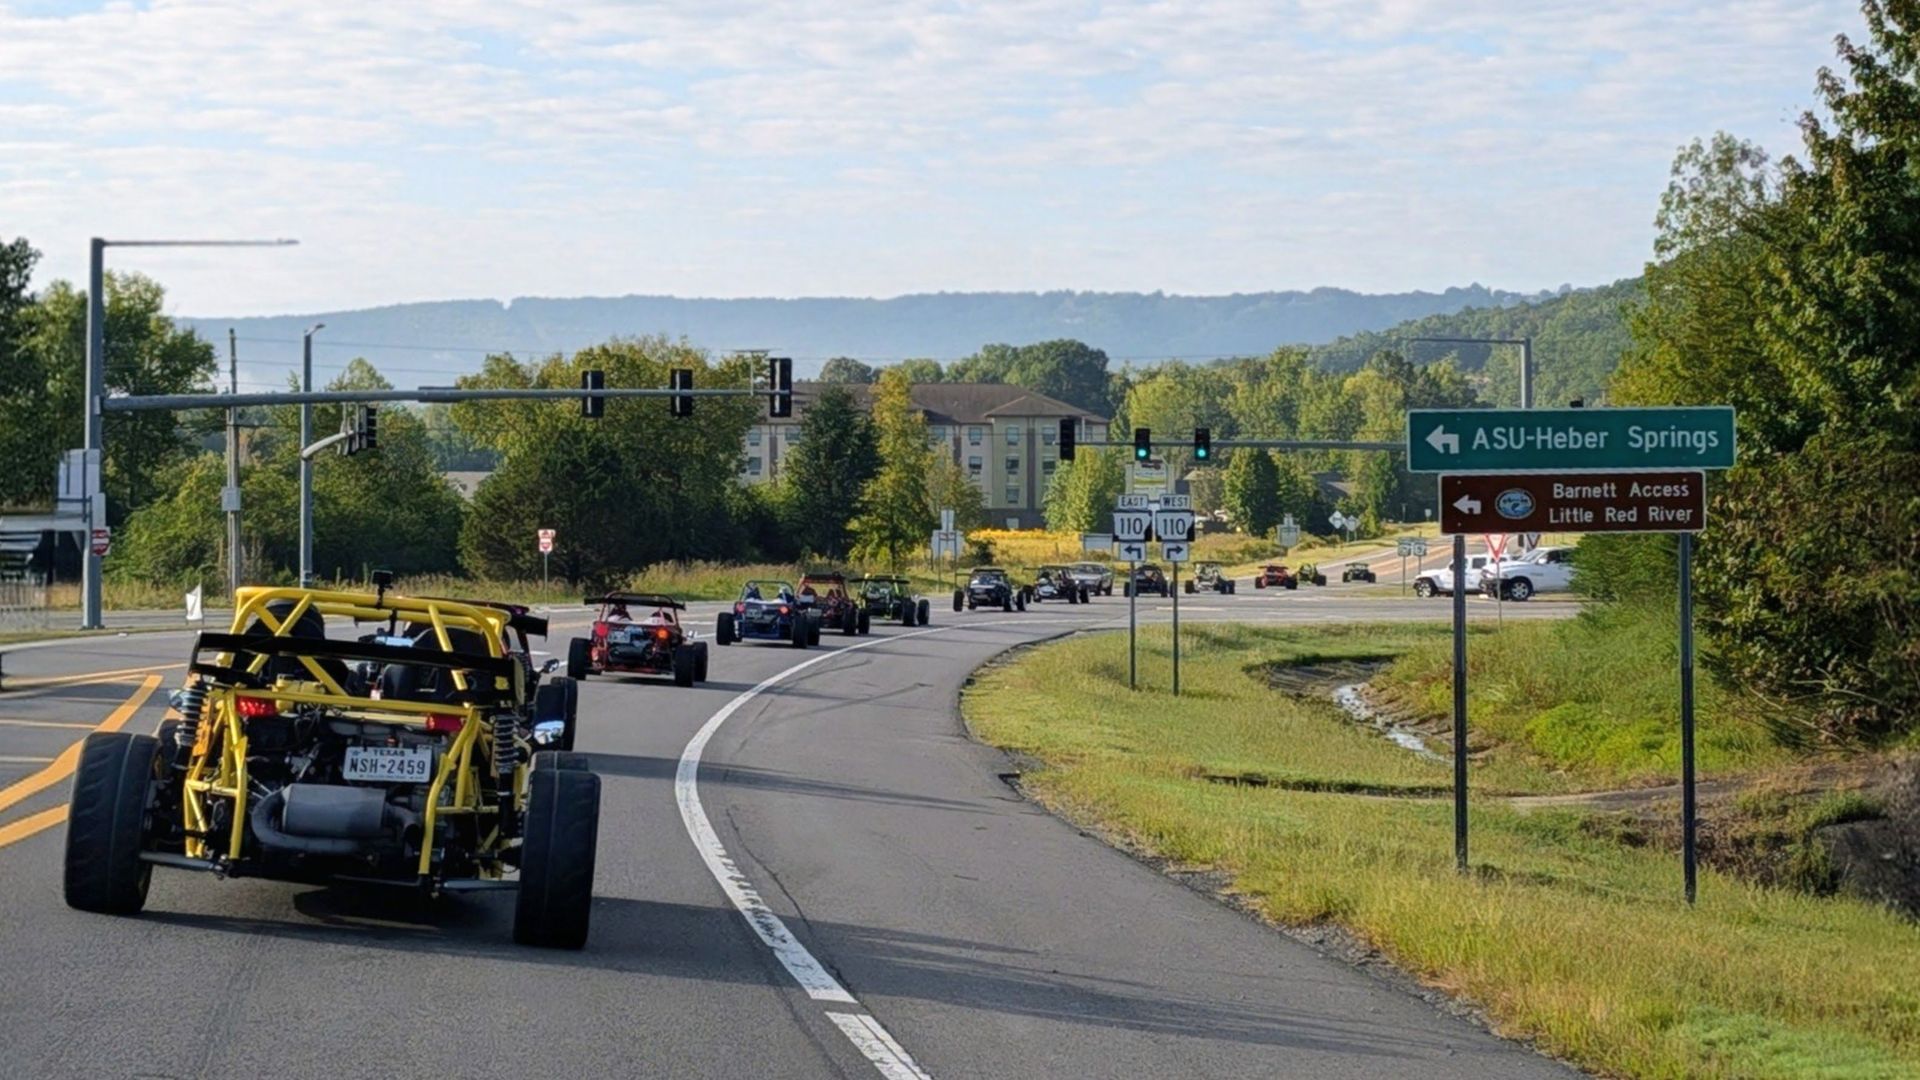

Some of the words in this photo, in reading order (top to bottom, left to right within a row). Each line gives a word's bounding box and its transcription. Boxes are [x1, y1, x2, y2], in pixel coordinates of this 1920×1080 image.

[1472, 426, 1609, 450] ASU-Heber
[1628, 425, 1719, 454] Springs
[1553, 482, 1617, 499] Barnett
[1629, 482, 1689, 498] Access
[1121, 496, 1144, 507] EAST
[1163, 496, 1188, 507] WEST
[1549, 507, 1594, 524] Little
[1605, 506, 1638, 522] Red
[1648, 506, 1693, 522] River
[1120, 518, 1143, 535] 110
[1163, 518, 1186, 535] 110
[374, 749, 406, 757] TEXAS
